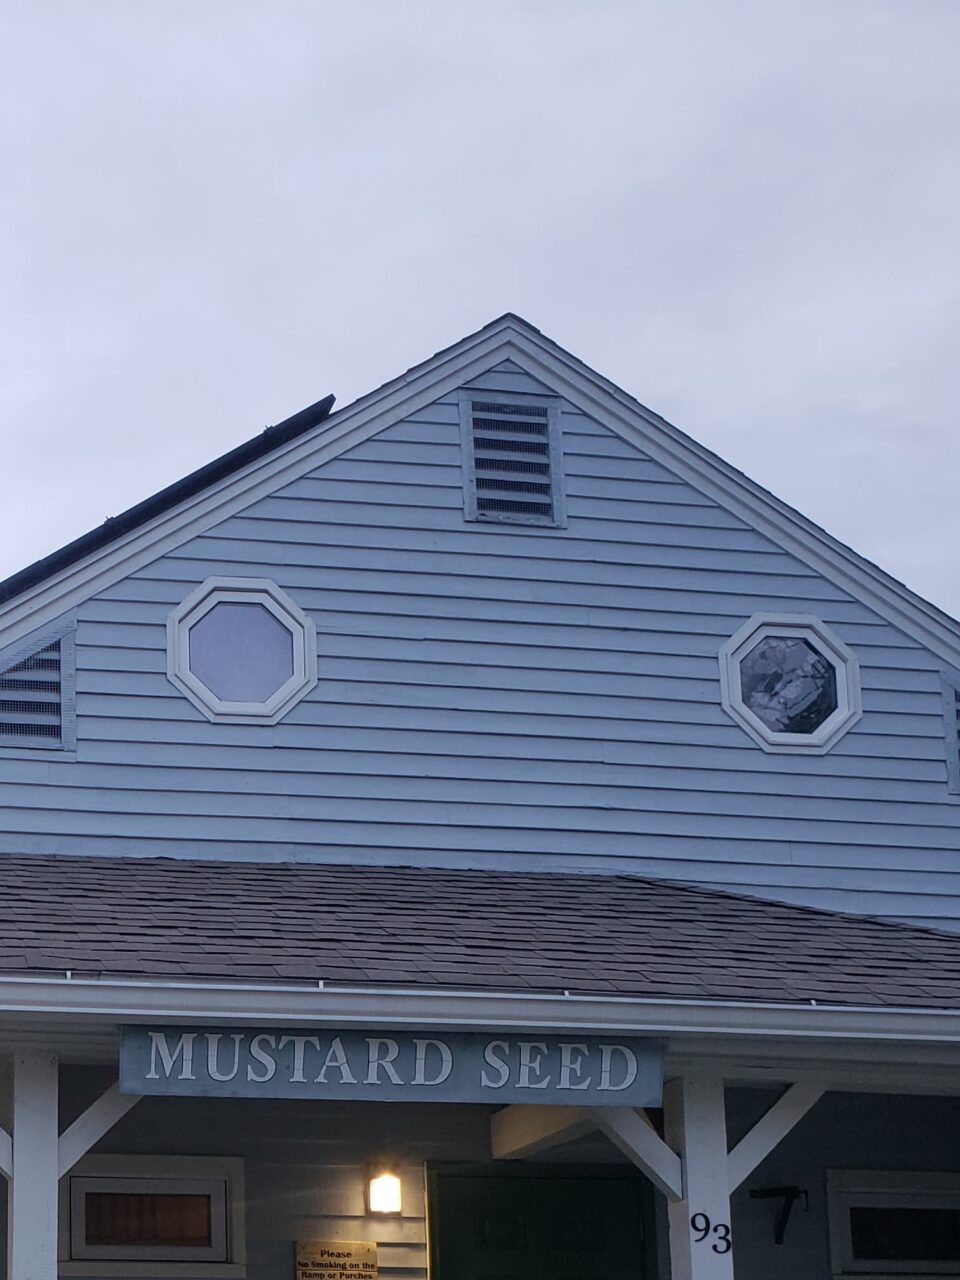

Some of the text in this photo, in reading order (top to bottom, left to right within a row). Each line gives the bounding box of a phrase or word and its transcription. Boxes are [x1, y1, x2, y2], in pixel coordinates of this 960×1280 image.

[144, 1031, 640, 1093] MUSTARD SEED
[690, 1212, 732, 1254] 93
[320, 1249, 352, 1258] Please
[311, 1261, 347, 1270] Smoking
[301, 1271, 325, 1280] Ramp
[339, 1272, 373, 1280] Porches
